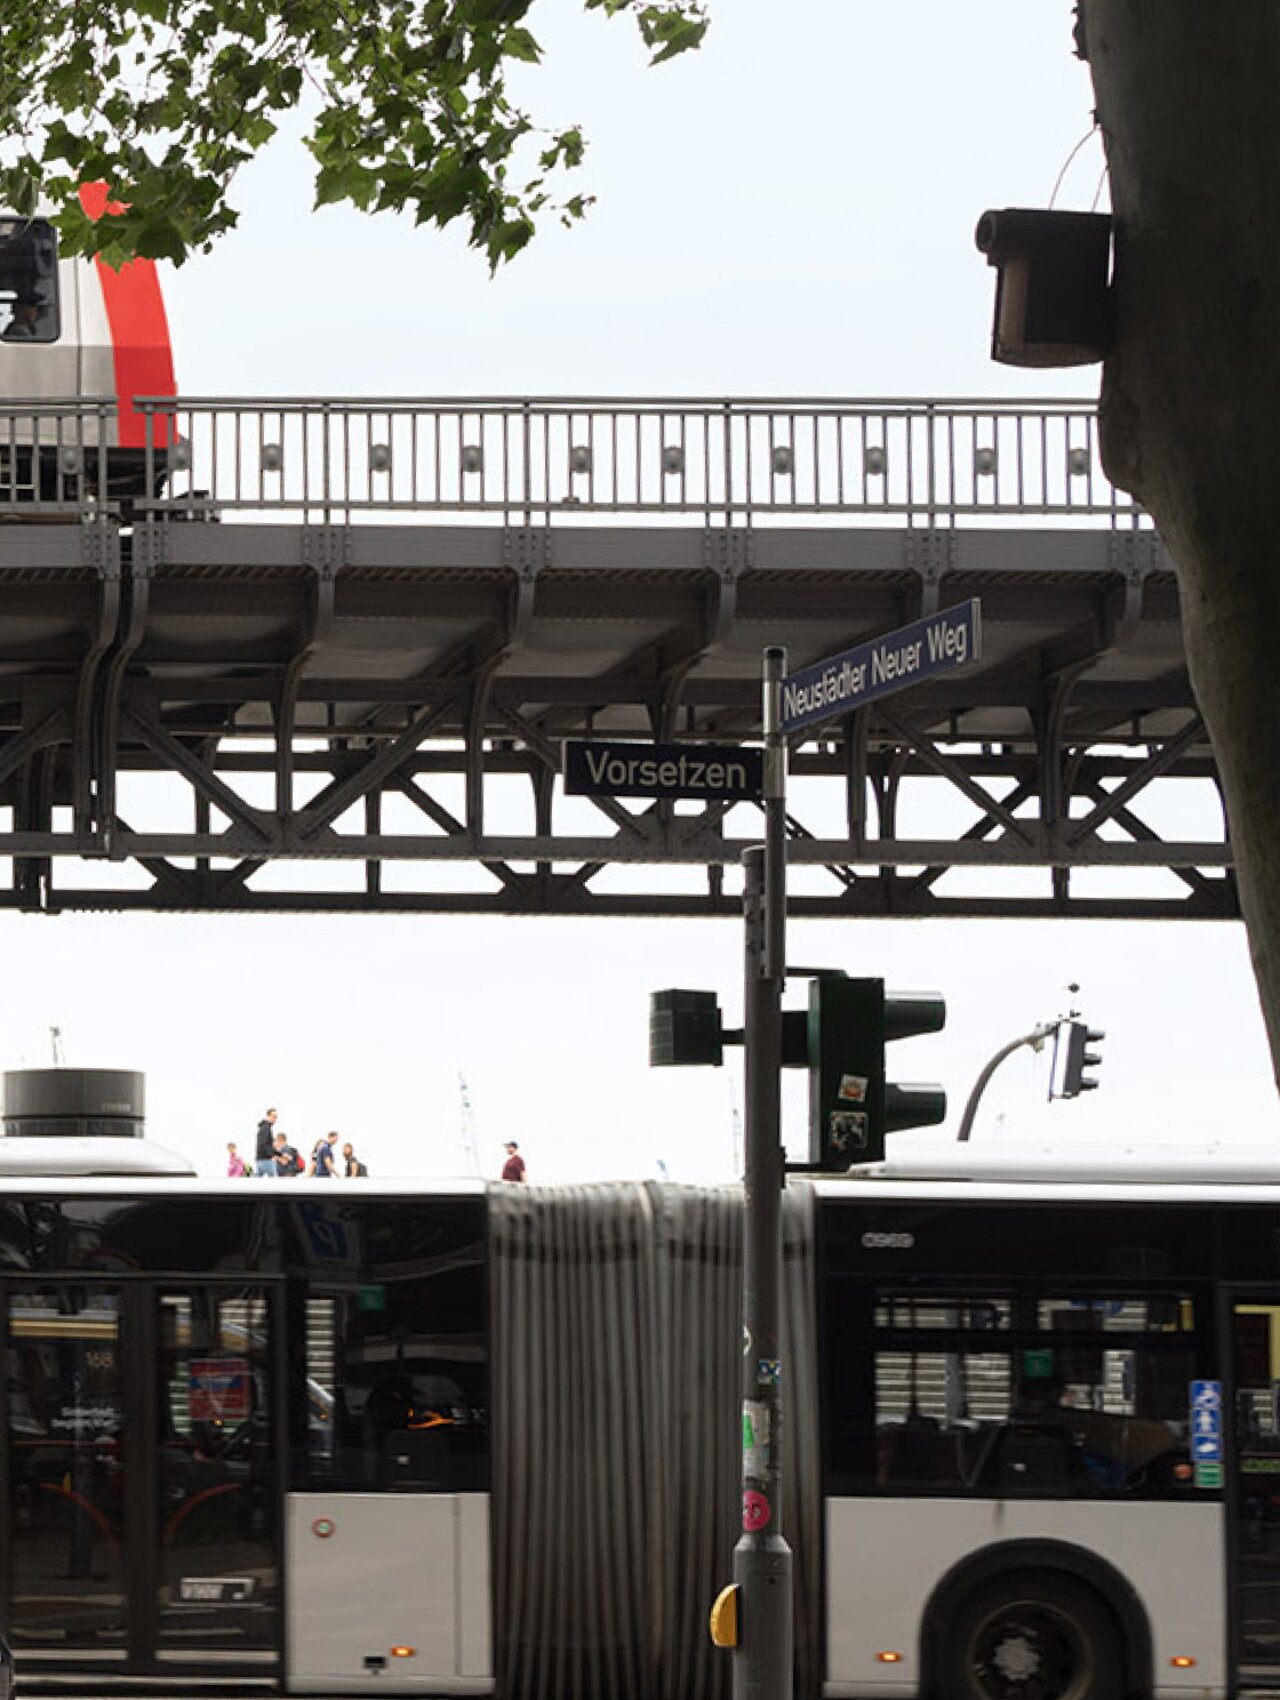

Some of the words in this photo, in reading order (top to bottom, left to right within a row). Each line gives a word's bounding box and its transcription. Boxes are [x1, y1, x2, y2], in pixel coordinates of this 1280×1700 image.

[783, 663, 866, 721] Neustädter
[871, 640, 922, 686] Neuer
[926, 621, 968, 662] Weg
[585, 750, 747, 788] Vorsetzen
